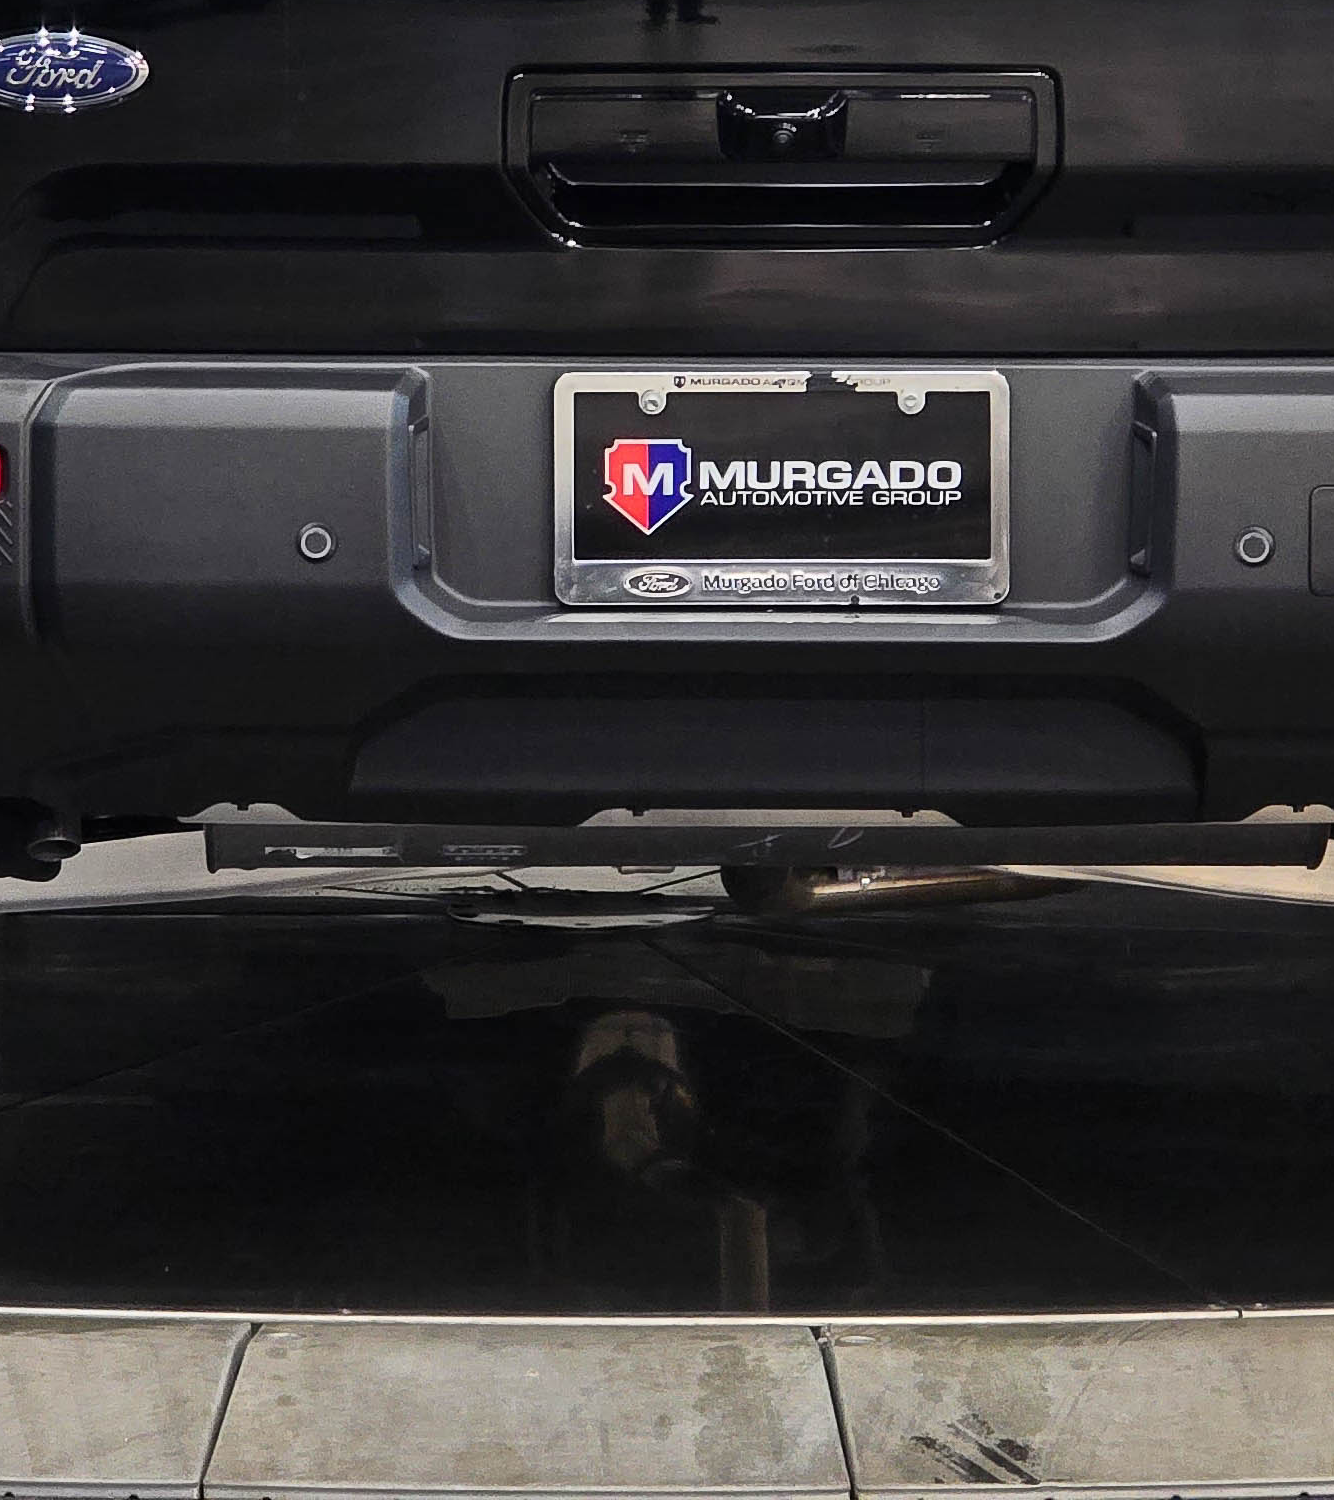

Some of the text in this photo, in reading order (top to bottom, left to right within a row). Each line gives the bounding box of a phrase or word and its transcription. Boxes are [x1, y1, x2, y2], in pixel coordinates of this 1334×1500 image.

[6, 47, 104, 89] Ford
[622, 462, 674, 496] M
[699, 460, 962, 490] MURGADO
[700, 490, 962, 506] AUTOMOTIVE GROUP
[638, 574, 680, 592] Ford
[703, 573, 941, 593] Murgado Ford of Chicago
